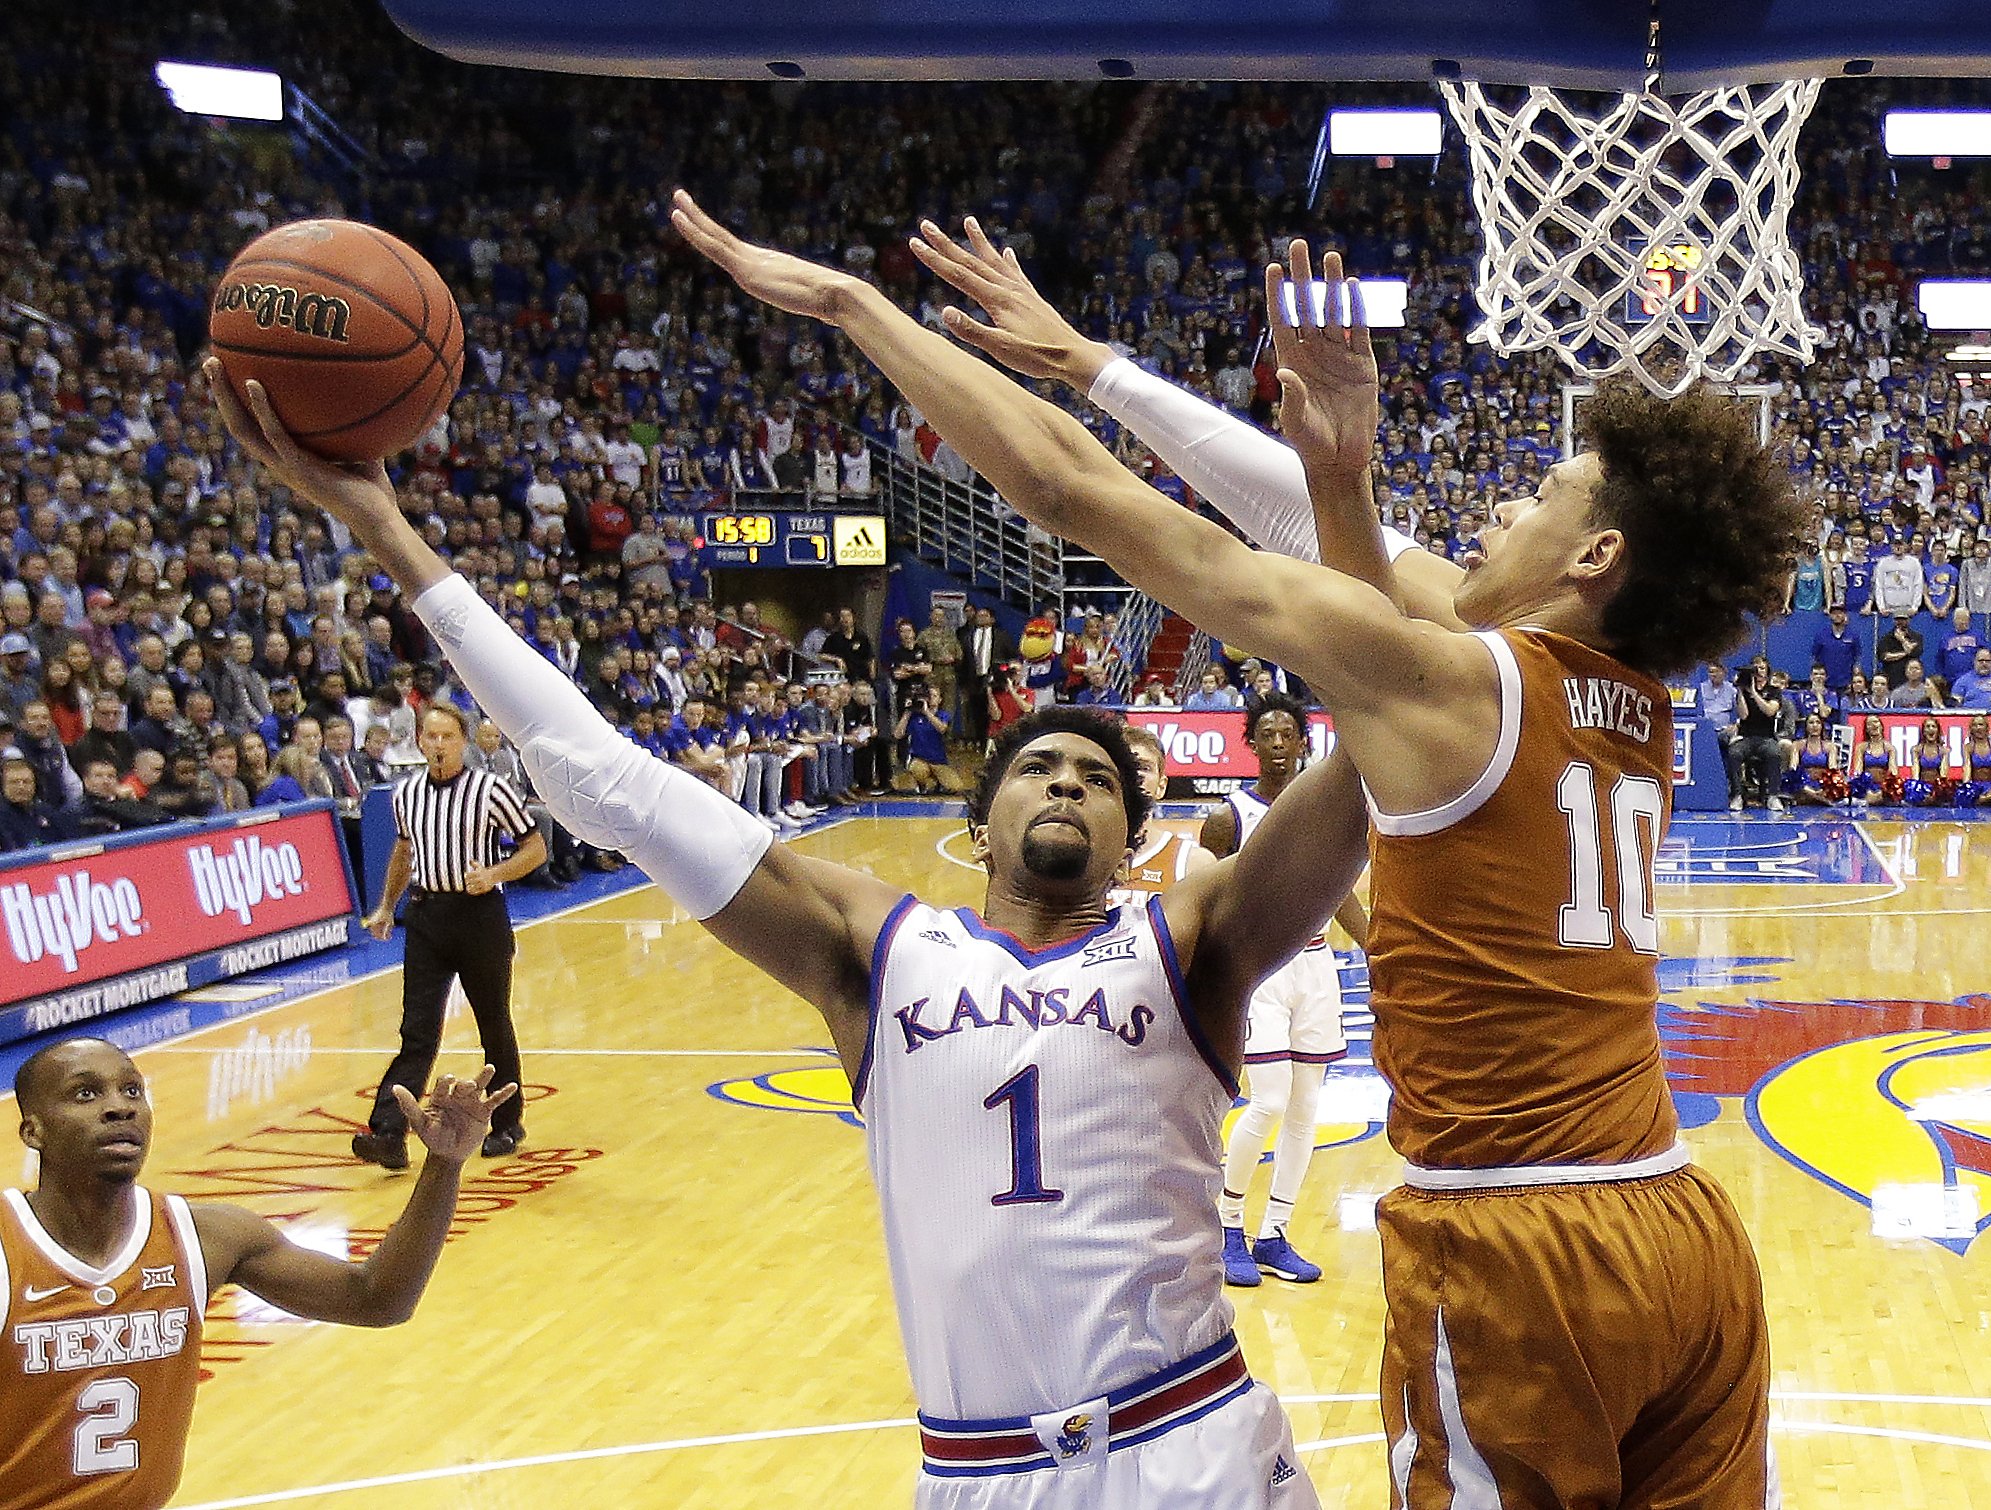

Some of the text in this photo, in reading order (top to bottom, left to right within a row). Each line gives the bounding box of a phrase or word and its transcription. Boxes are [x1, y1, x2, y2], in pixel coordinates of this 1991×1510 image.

[214, 283, 351, 344] Wilson
[714, 516, 771, 543] 15:58
[810, 535, 825, 559] 7
[840, 547, 882, 559] adidas
[1146, 722, 1226, 765] Vee
[1563, 678, 1652, 744] HAYES
[188, 835, 303, 926] HyVee
[1557, 761, 1664, 957] 10
[1, 870, 142, 973] HyVee
[102, 962, 189, 1013] MORTGAGE
[894, 984, 1155, 1053] KANSAS
[983, 1064, 1064, 1207] 1
[15, 1307, 190, 1374] TEXAS
[73, 1377, 140, 1477] 2
